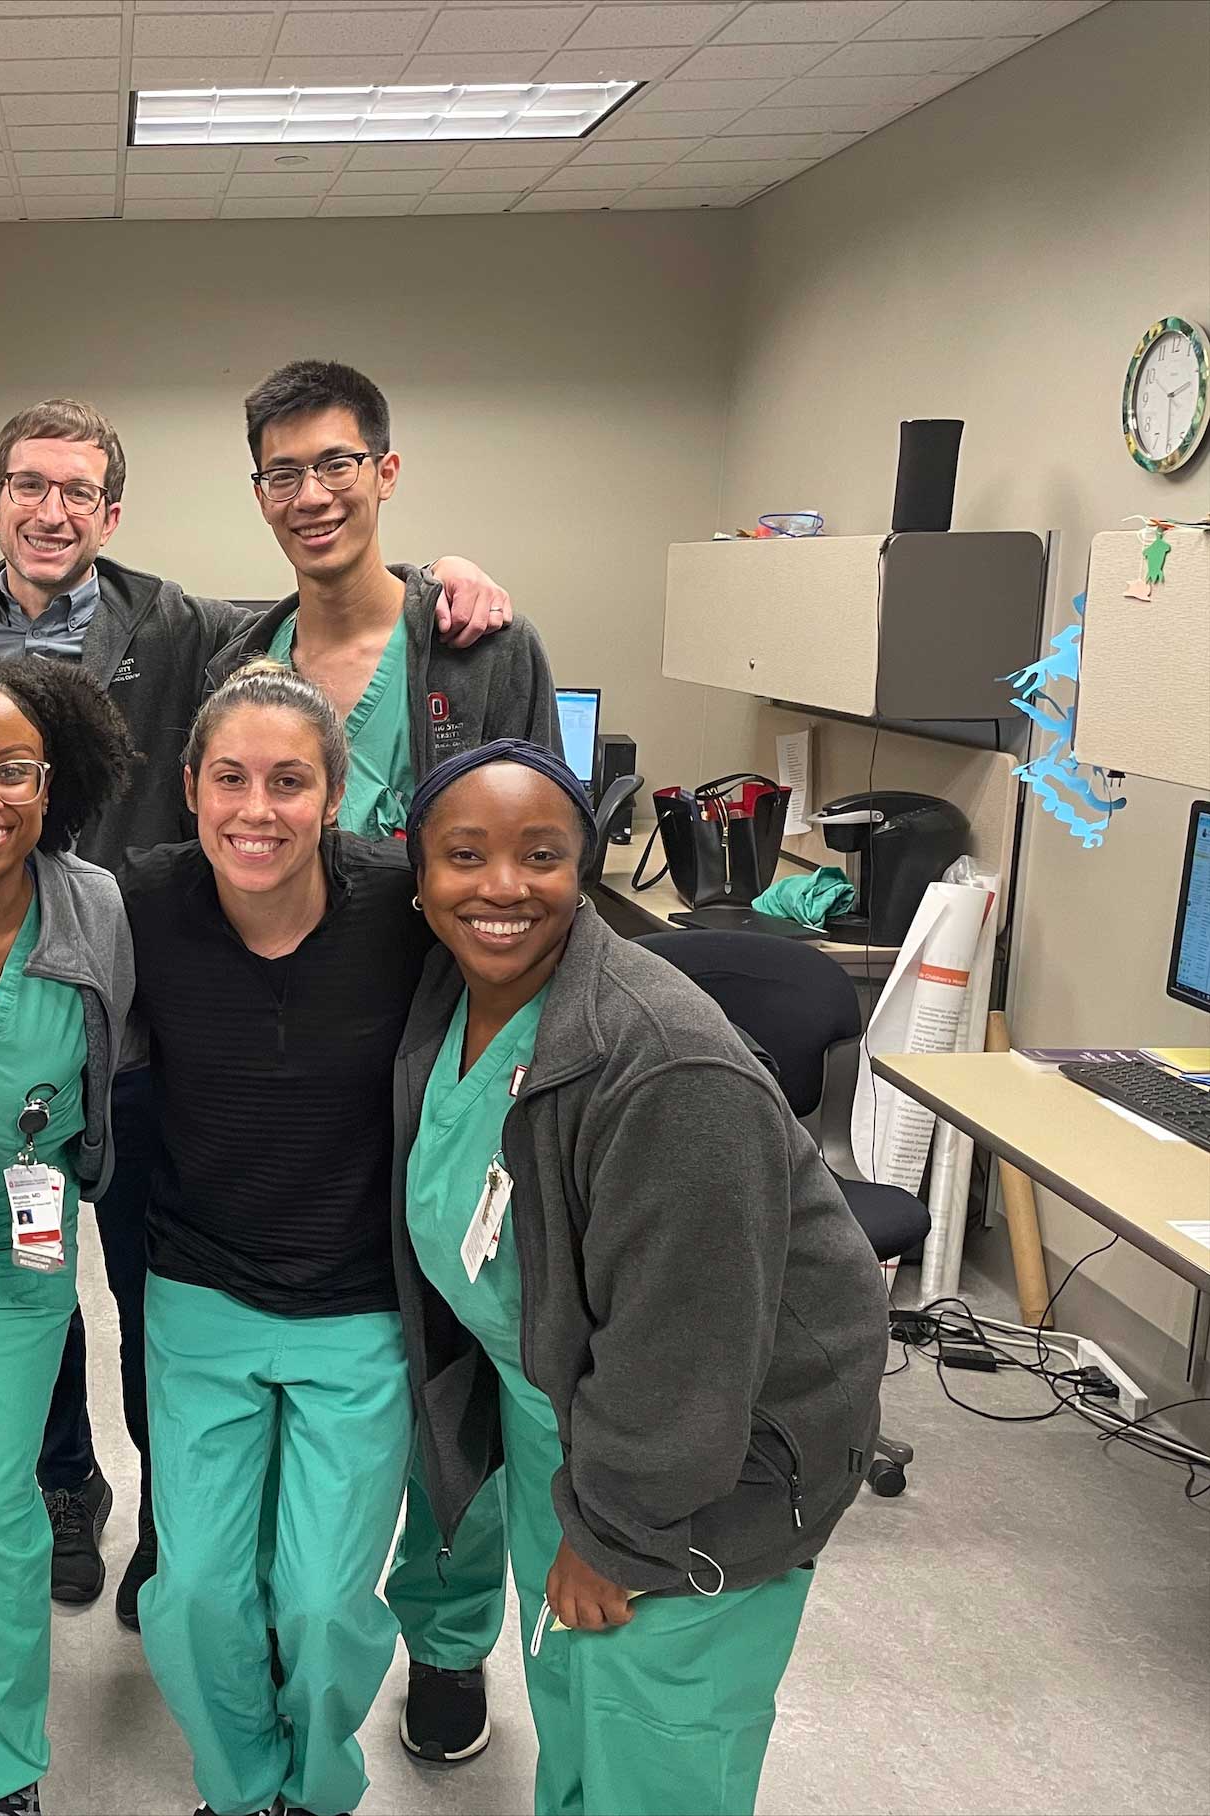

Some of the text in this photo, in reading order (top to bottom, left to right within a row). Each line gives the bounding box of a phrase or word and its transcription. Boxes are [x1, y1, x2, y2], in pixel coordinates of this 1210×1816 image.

[1157, 344, 1166, 362] 11
[1171, 335, 1182, 354] 12
[1145, 367, 1157, 385] 10
[1142, 391, 1149, 409] 9
[1144, 416, 1151, 433] 8
[1152, 432, 1161, 450] 7
